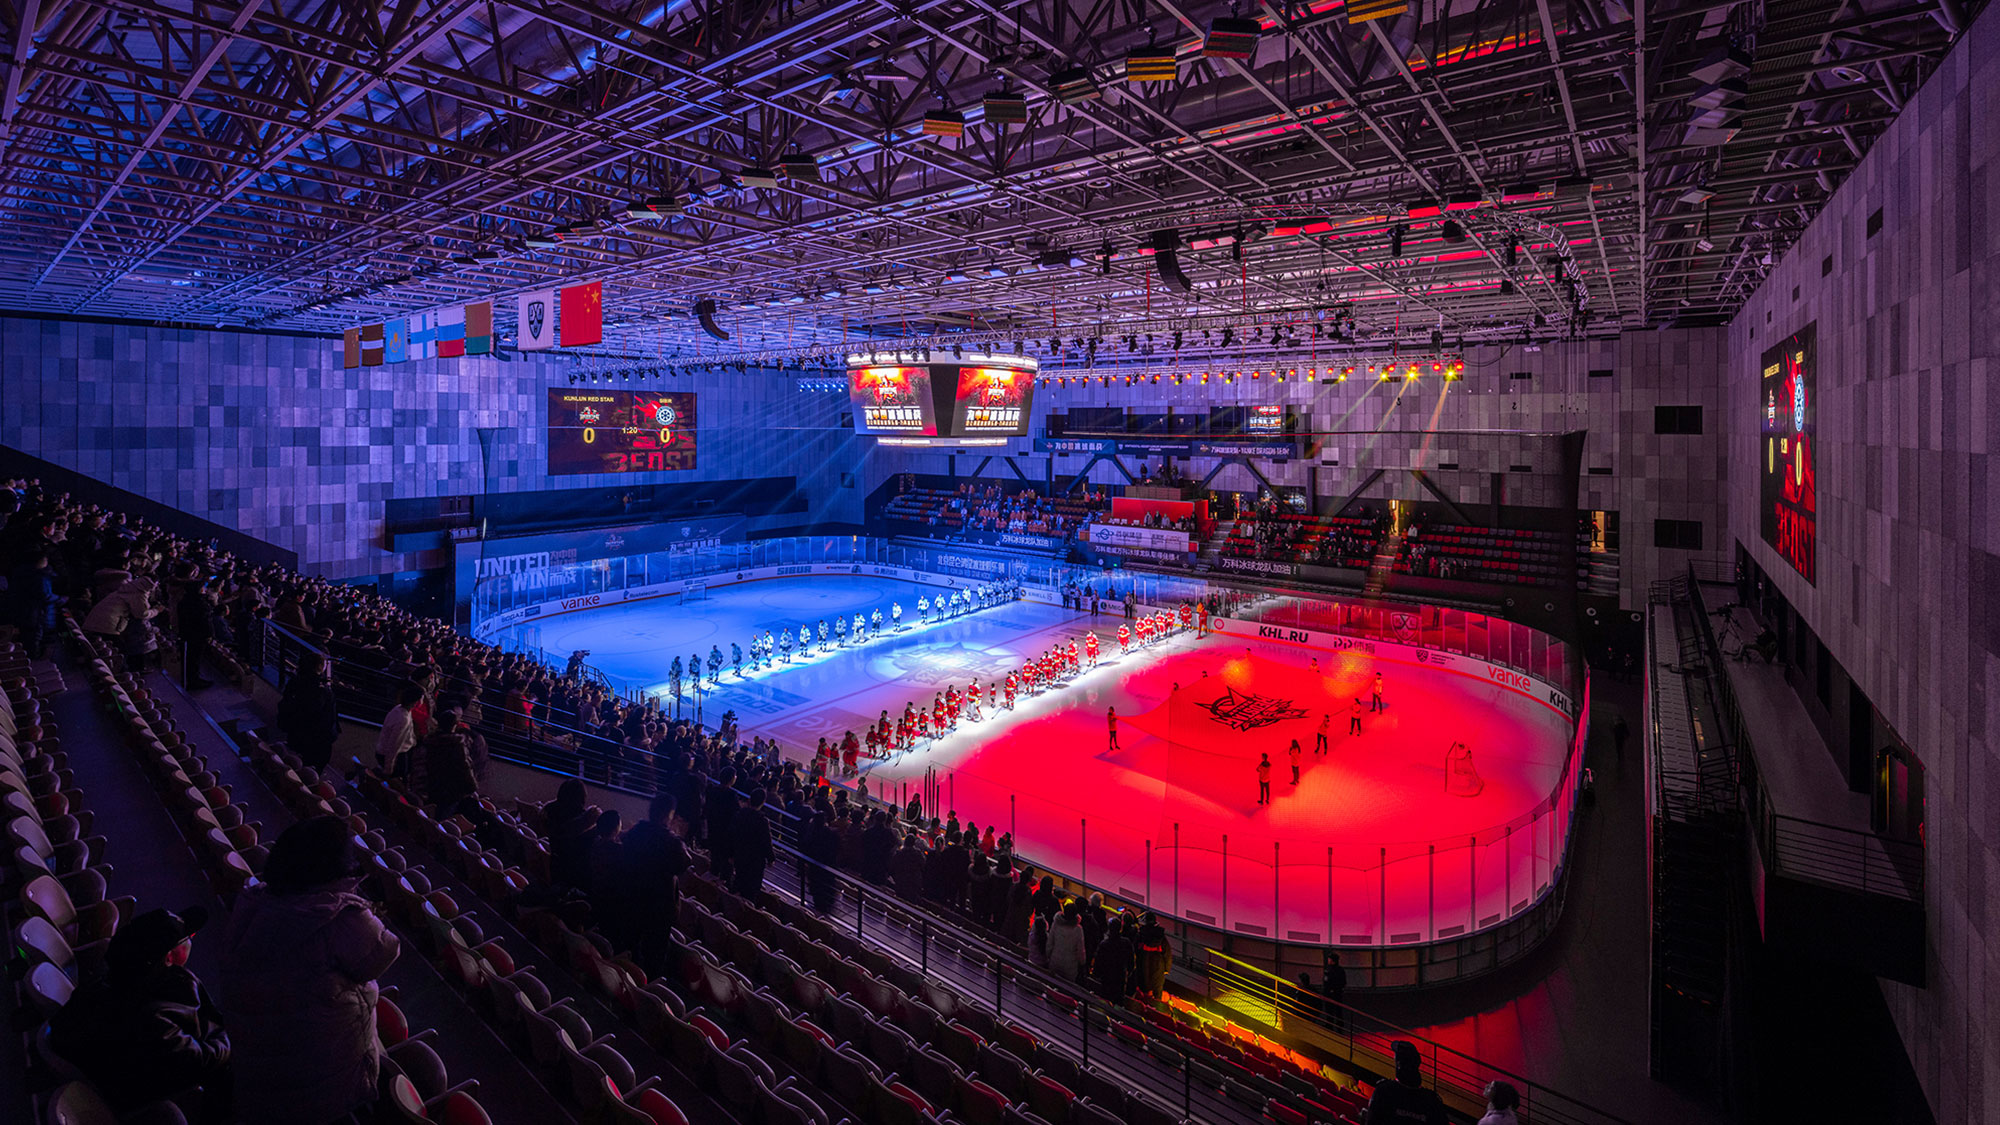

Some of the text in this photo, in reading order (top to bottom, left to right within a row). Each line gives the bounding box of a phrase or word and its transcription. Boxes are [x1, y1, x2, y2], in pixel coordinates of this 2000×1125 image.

[583, 427, 595, 443] 0
[660, 427, 670, 443] 0
[1796, 441, 1803, 487] 0
[474, 551, 550, 578] UNITED
[510, 568, 550, 592] WIN
[561, 595, 600, 610] vanke
[1258, 625, 1309, 643] KHL.RU
[1487, 665, 1531, 692] vanke
